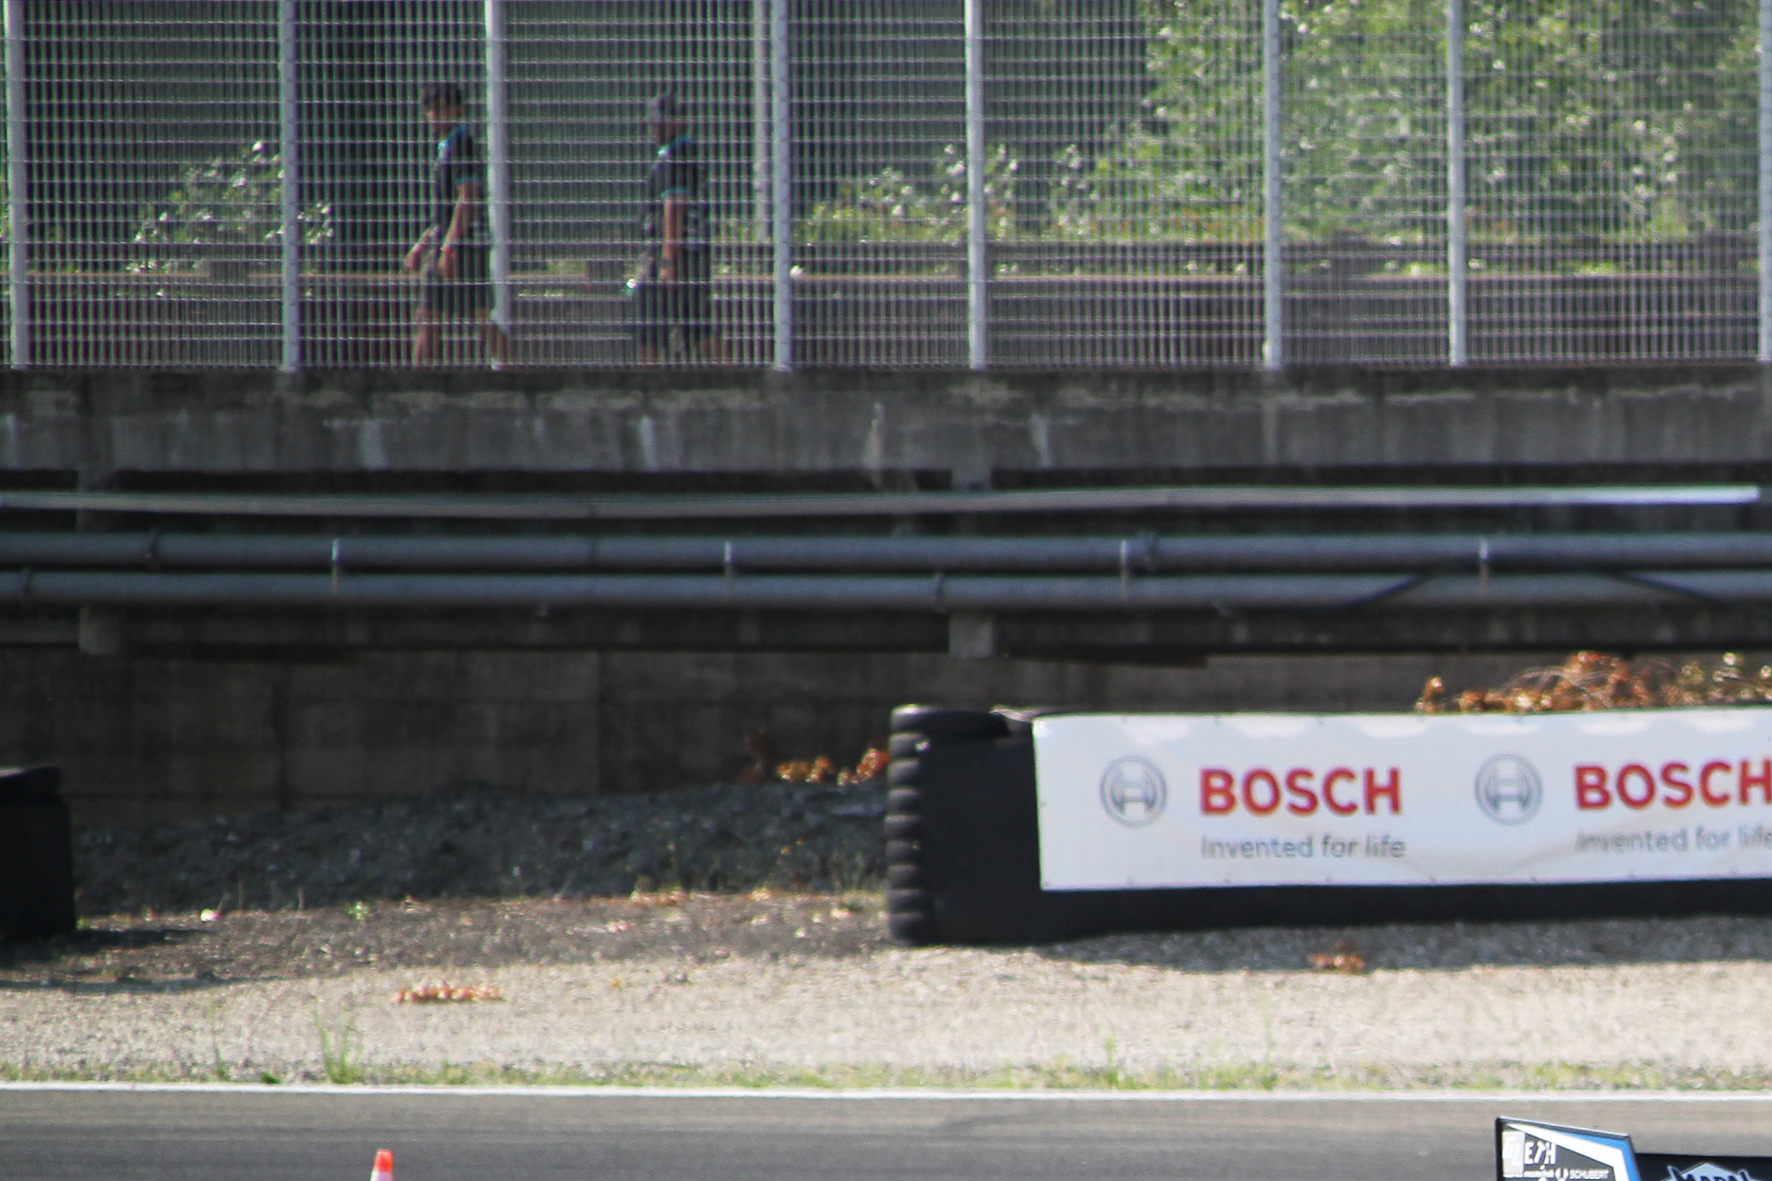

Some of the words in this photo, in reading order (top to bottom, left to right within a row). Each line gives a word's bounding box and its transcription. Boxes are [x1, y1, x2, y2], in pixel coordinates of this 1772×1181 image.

[1200, 766, 1402, 817] BOSCH
[1201, 836, 1315, 858] Invented
[1322, 833, 1358, 859] for
[1365, 834, 1406, 858] life
[1696, 826, 1732, 851] for
[1569, 1168, 1610, 1180] SCHUBERT
